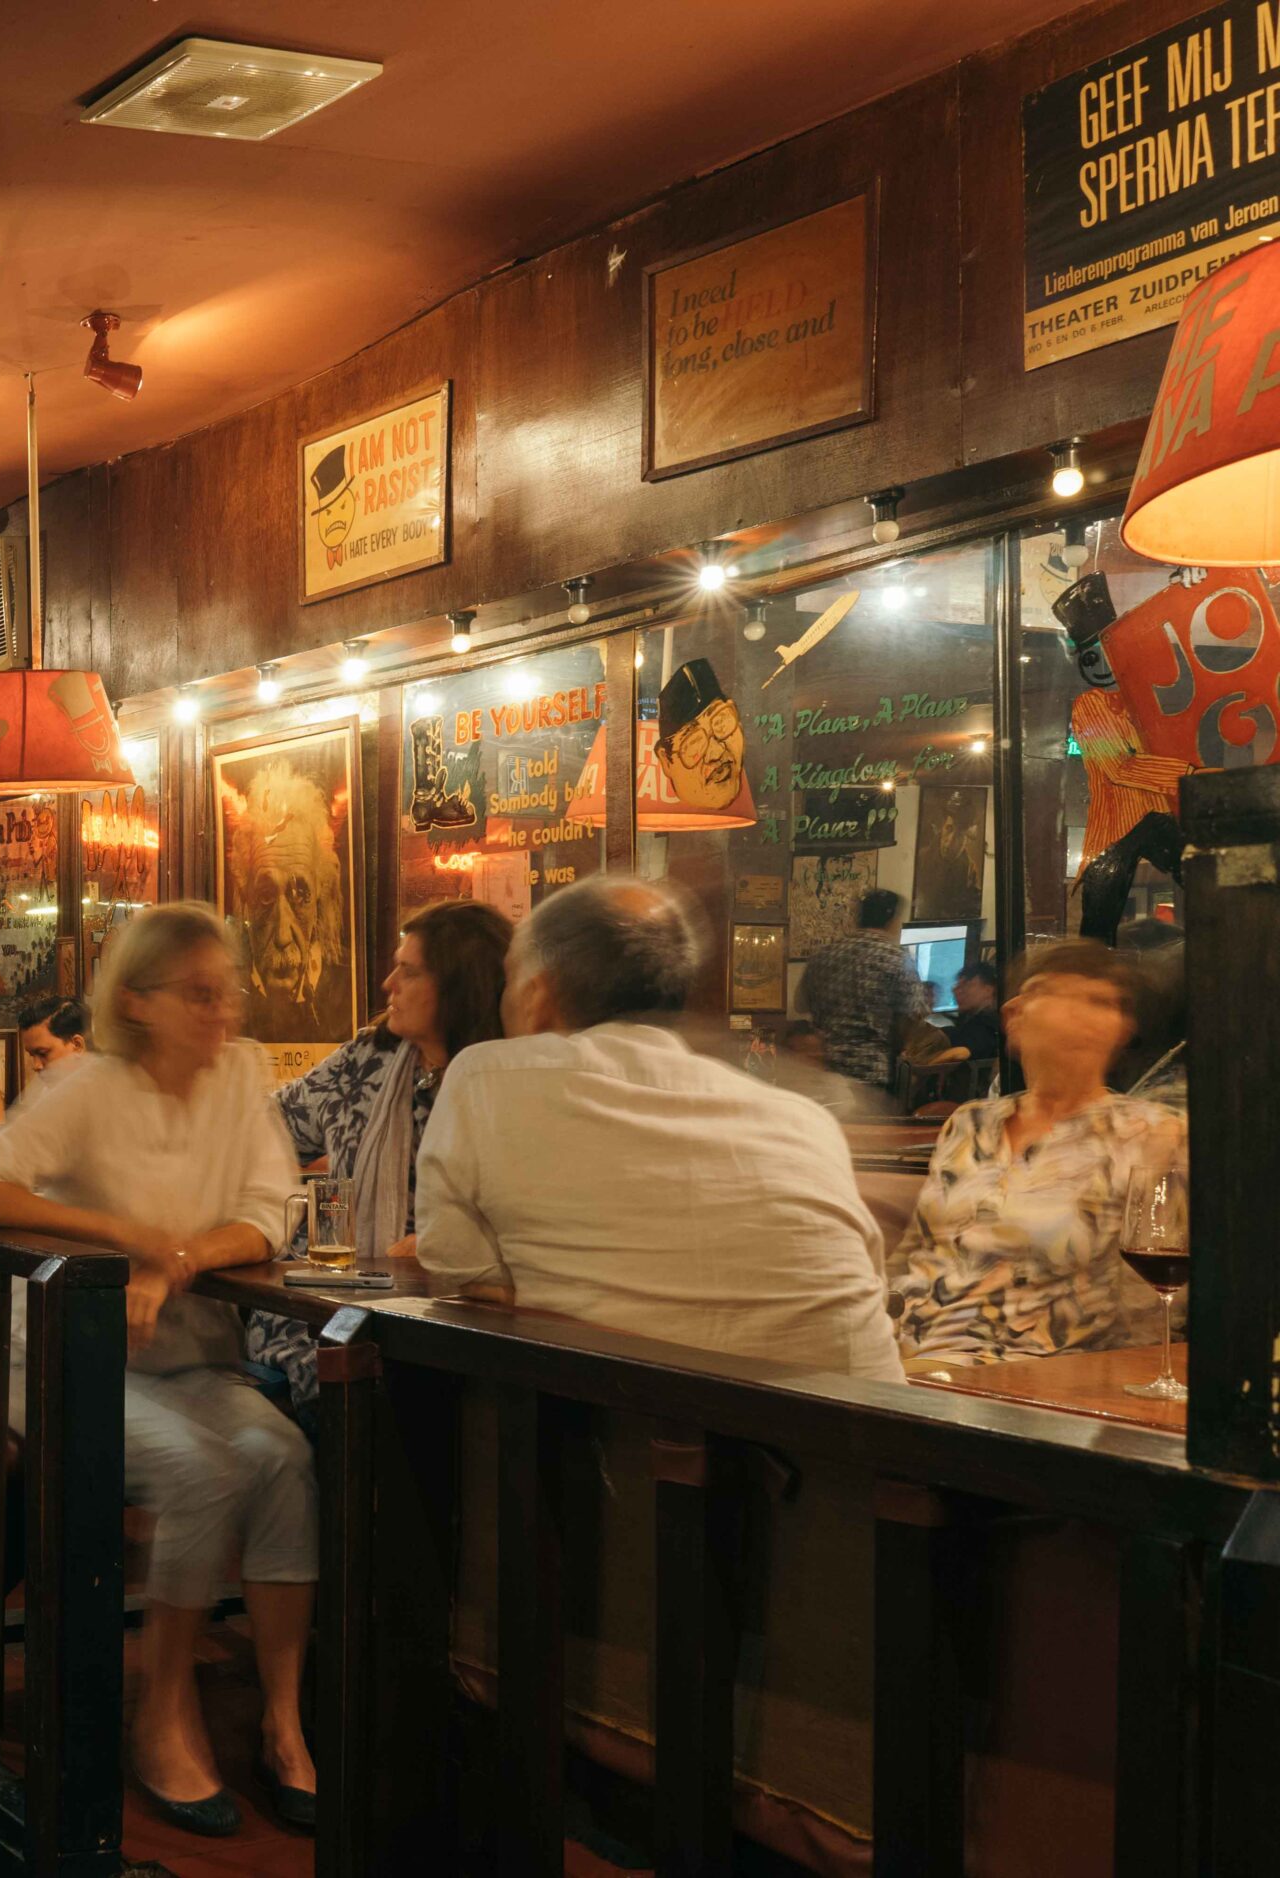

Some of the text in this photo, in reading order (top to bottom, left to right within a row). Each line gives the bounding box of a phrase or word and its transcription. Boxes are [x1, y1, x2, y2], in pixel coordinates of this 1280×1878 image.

[1079, 56, 1150, 150] GEEF
[1167, 19, 1232, 113] MIJ
[1079, 112, 1215, 229] SPERMA
[1044, 195, 1279, 297] Liederenprogramma van Jeroen
[667, 280, 808, 349] to be HELD
[671, 268, 737, 318] I need
[1028, 250, 1244, 339] THEATER ZUIDPLE
[722, 330, 780, 362] close
[786, 299, 837, 344] and
[1072, 328, 1086, 338] DO
[349, 410, 436, 477] I AM NOT
[363, 456, 435, 516] RASIST
[349, 537, 368, 559] HATE
[370, 526, 399, 552] EVERY
[455, 681, 607, 747] BE YOURSELF
[527, 750, 558, 778] told
[787, 752, 898, 804] Kingdom
[545, 866, 576, 884] was
